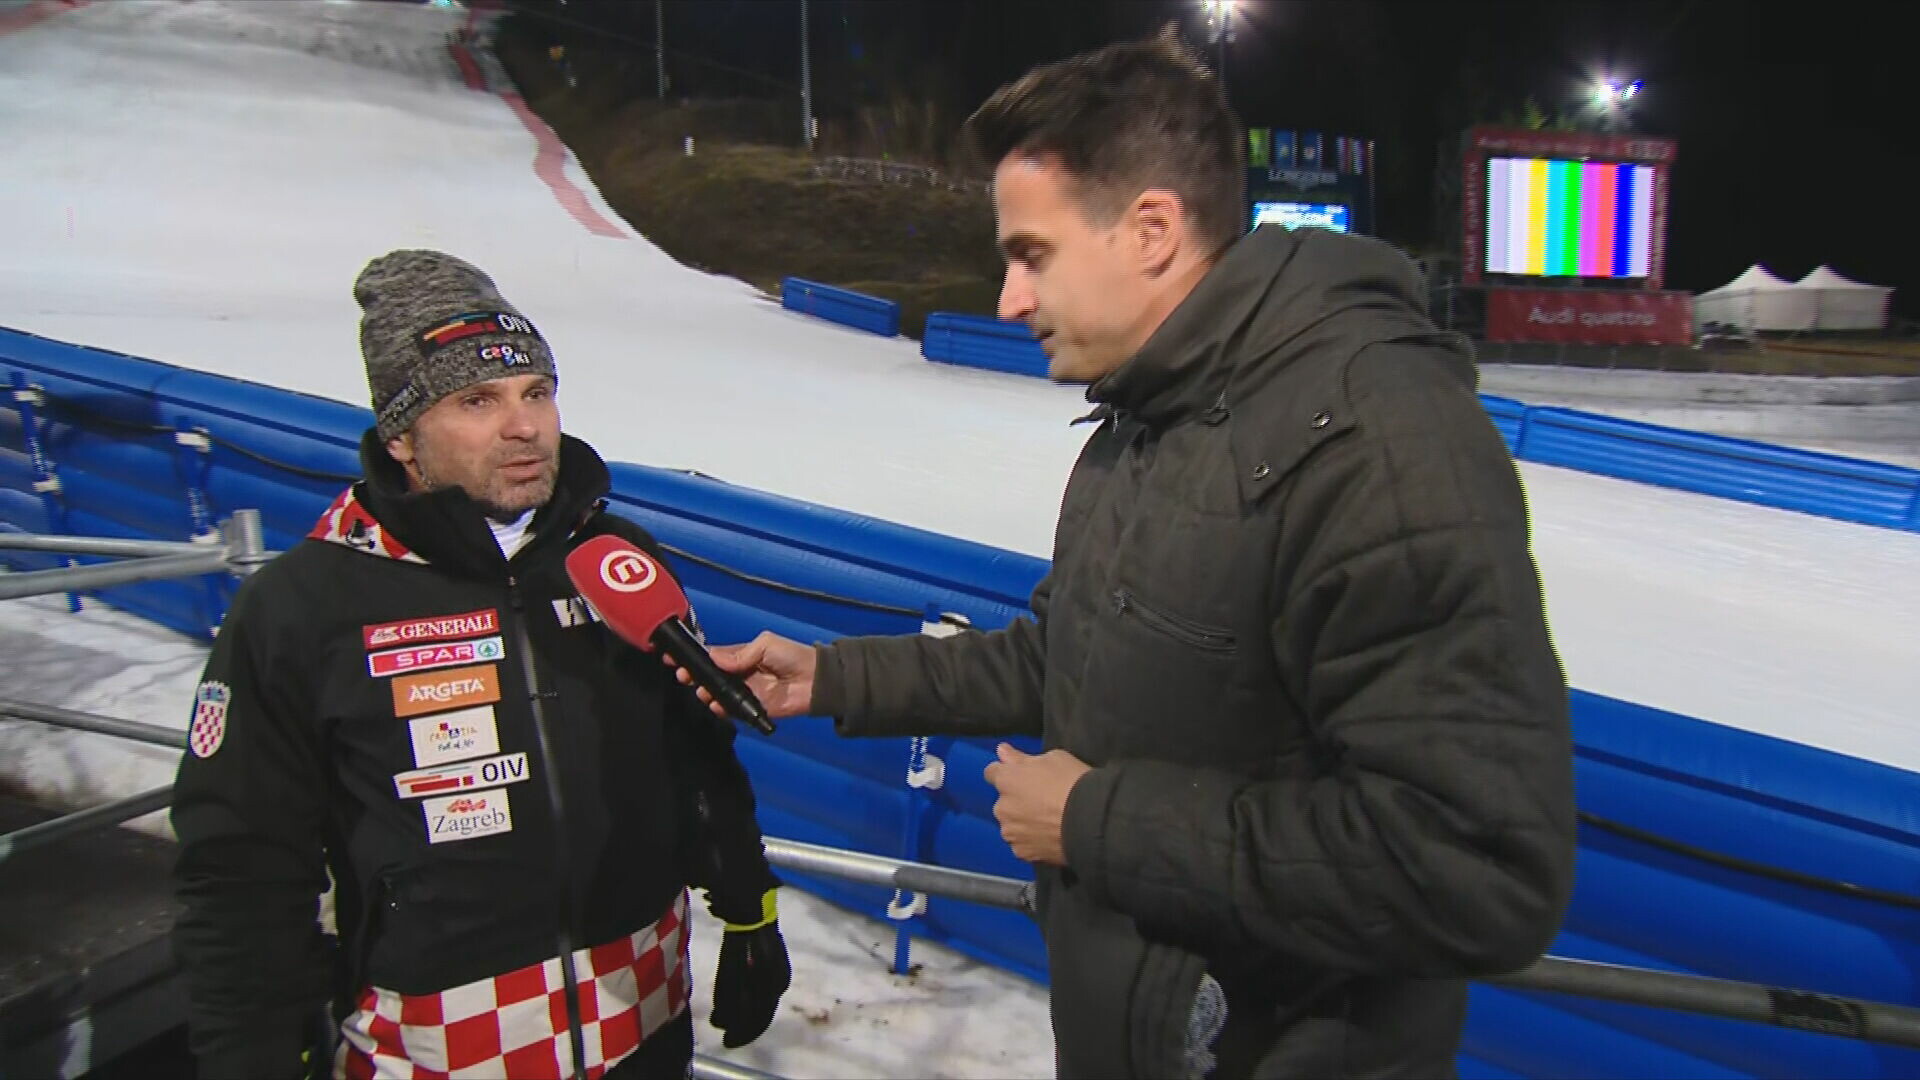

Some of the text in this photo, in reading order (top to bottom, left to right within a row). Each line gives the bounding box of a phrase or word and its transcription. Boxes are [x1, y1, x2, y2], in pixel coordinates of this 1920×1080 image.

[498, 314, 532, 334] OIV
[1528, 306, 1656, 327] Audi quattro
[400, 613, 494, 639] GENERALI
[396, 644, 472, 667] SPAR
[408, 678, 485, 702] ARGETA
[482, 757, 524, 782] OIV
[432, 807, 506, 836] Zagreb
